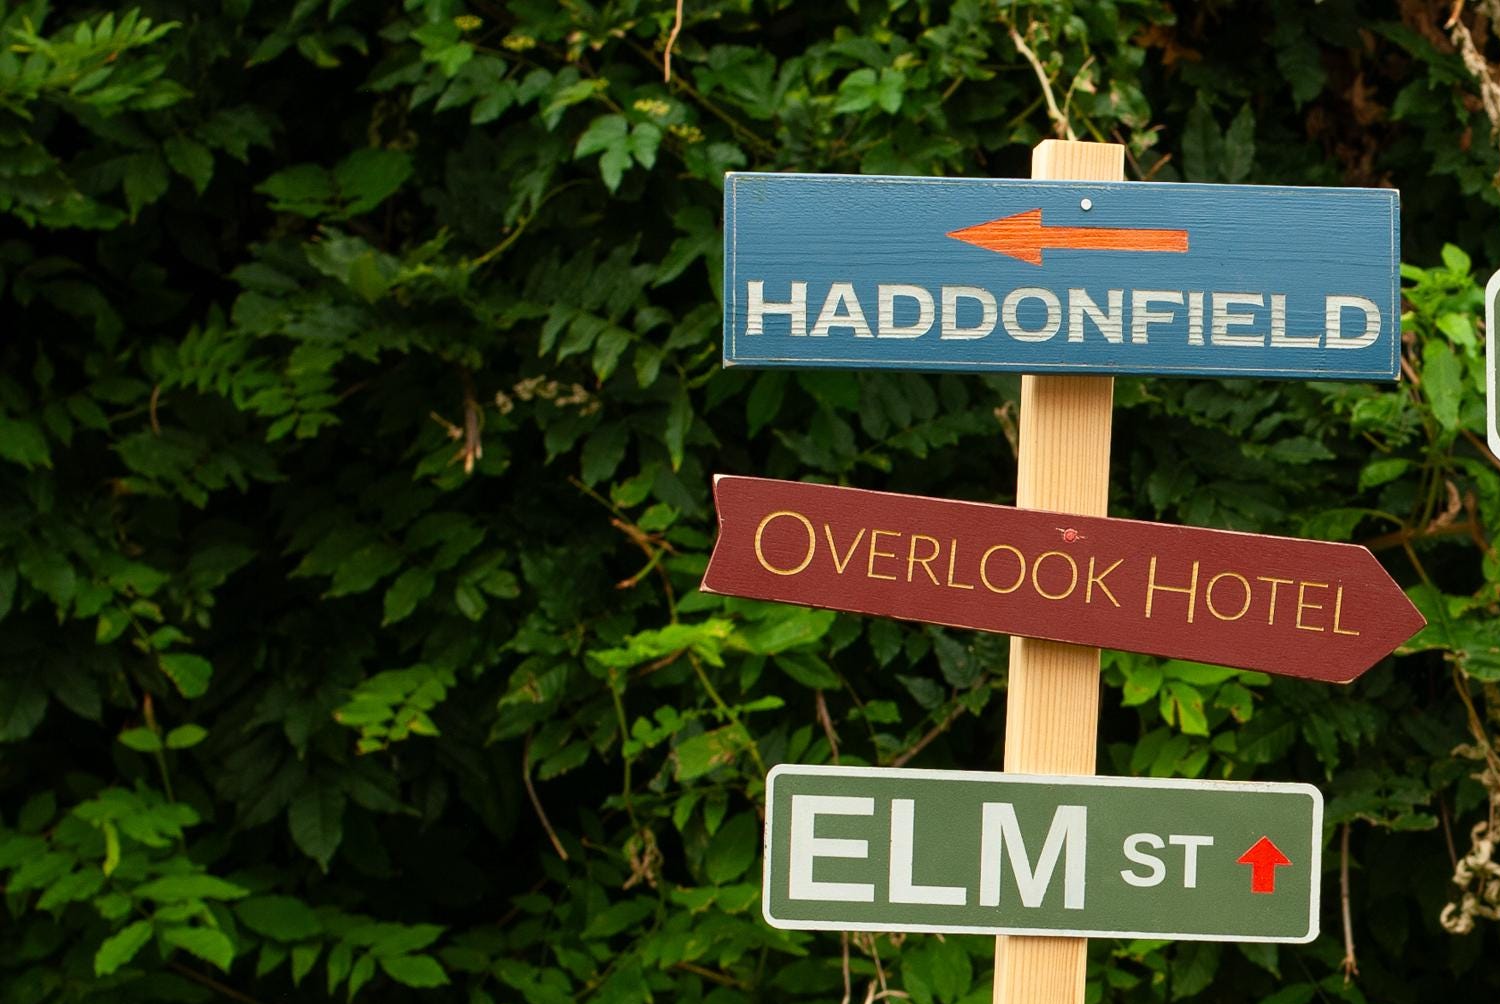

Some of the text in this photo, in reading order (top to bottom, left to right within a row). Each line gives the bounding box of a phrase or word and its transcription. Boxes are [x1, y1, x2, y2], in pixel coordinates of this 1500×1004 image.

[744, 280, 1383, 350] HADDONFIELD
[753, 510, 1361, 637] OVERLOOK HOTEL
[788, 794, 1215, 911] ELM ST
